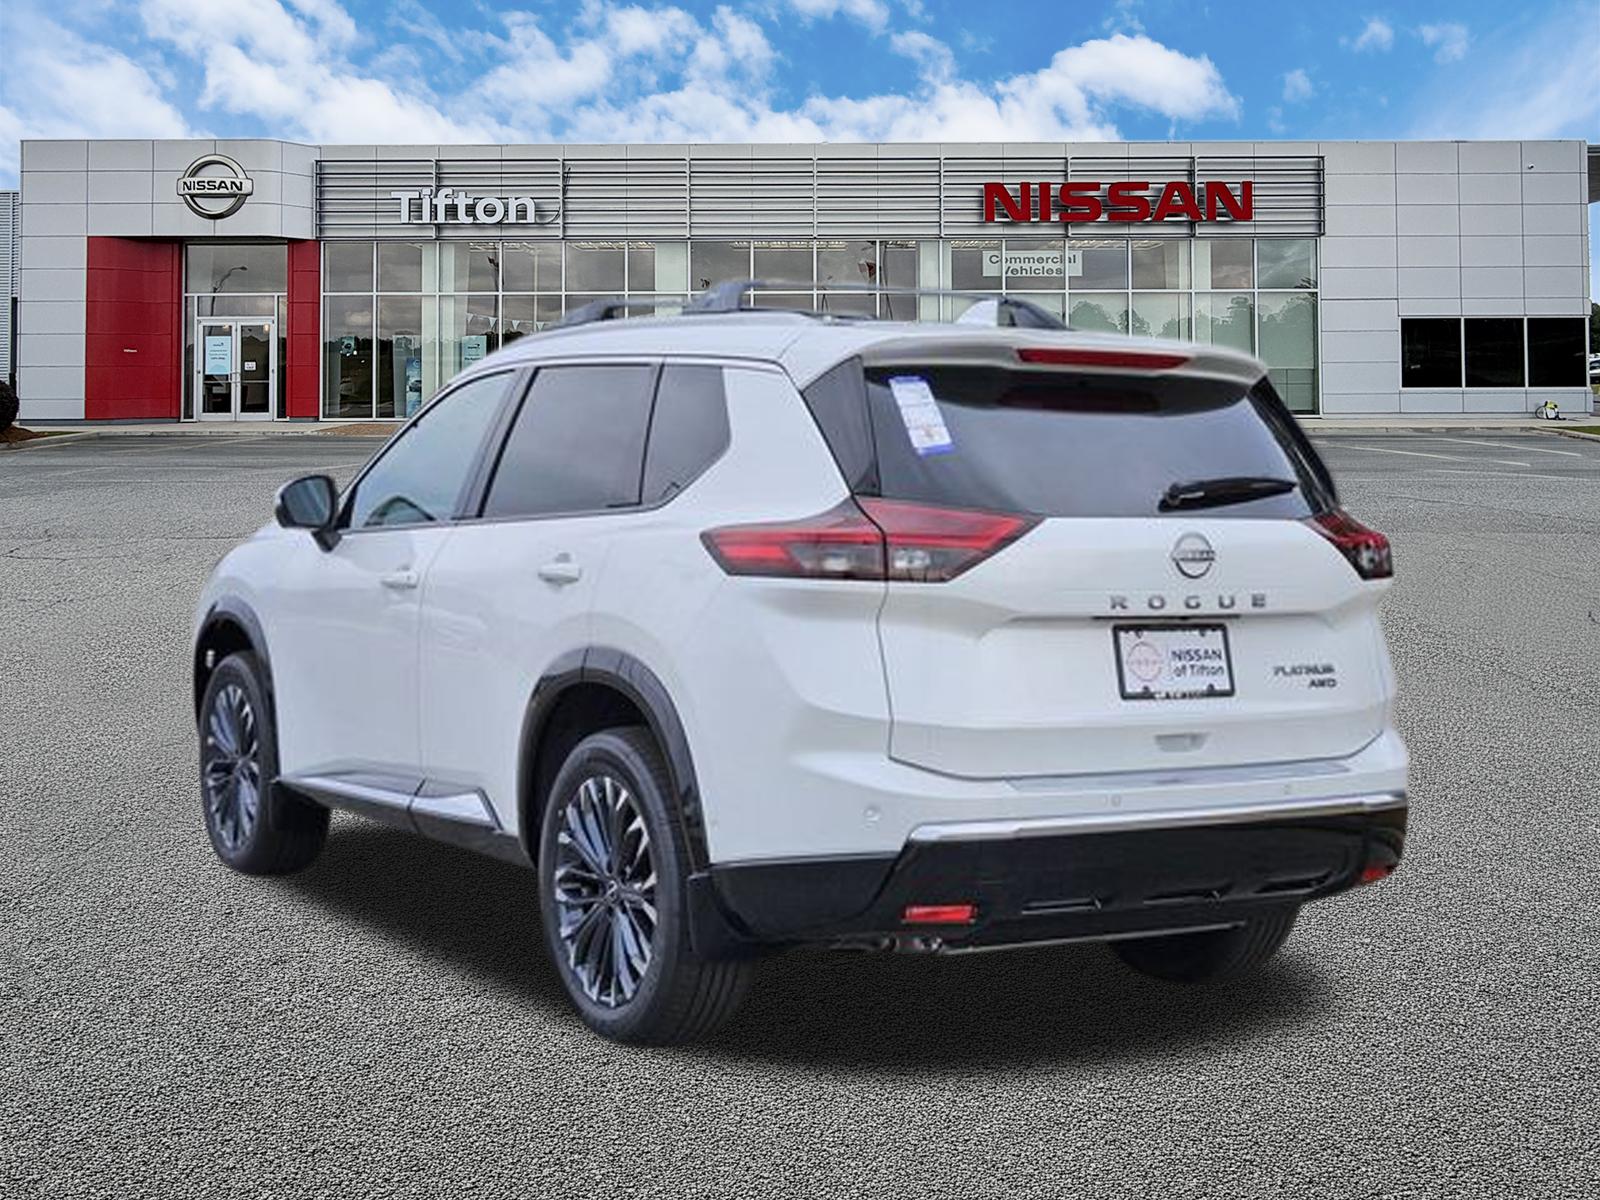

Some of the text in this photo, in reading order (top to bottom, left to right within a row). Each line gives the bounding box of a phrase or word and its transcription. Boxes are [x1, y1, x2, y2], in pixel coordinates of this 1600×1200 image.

[182, 180, 243, 192] NISSAN
[391, 188, 536, 225] Tifton
[983, 181, 1253, 222] NISSAN
[1110, 594, 1267, 610] ROGUE
[1171, 649, 1222, 661] NISSAN
